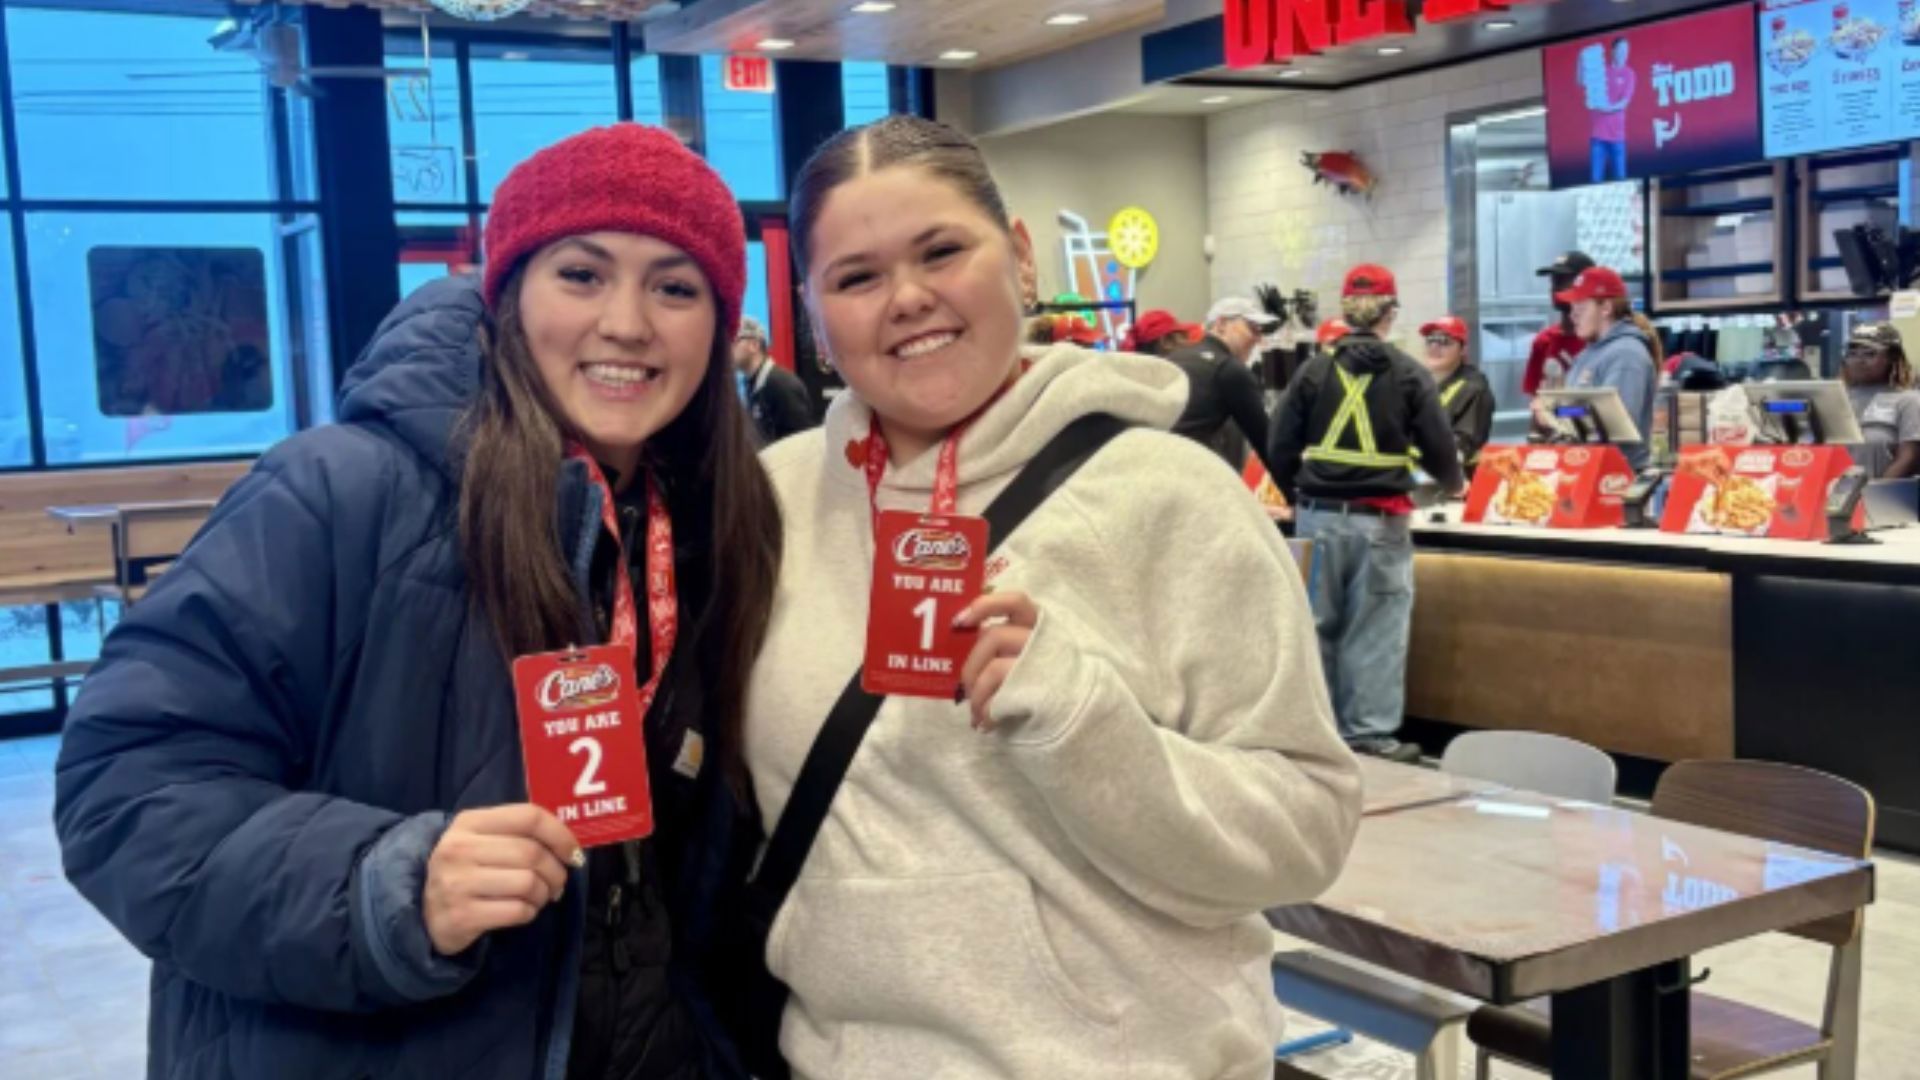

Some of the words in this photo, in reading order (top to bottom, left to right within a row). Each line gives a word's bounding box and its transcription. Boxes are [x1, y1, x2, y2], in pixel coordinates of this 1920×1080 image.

[730, 57, 766, 87] EXIT
[1652, 61, 1734, 107] TODD
[894, 574, 925, 589] YOU
[930, 576, 963, 593] ARE
[912, 597, 938, 650] 1
[887, 653, 908, 669] IN
[911, 656, 953, 673] LINE
[540, 664, 613, 711] Cane's
[544, 718, 579, 738] YOU
[585, 711, 621, 731] ARE
[568, 736, 606, 796] 2
[556, 803, 579, 821] IN
[582, 796, 627, 817] LINE
